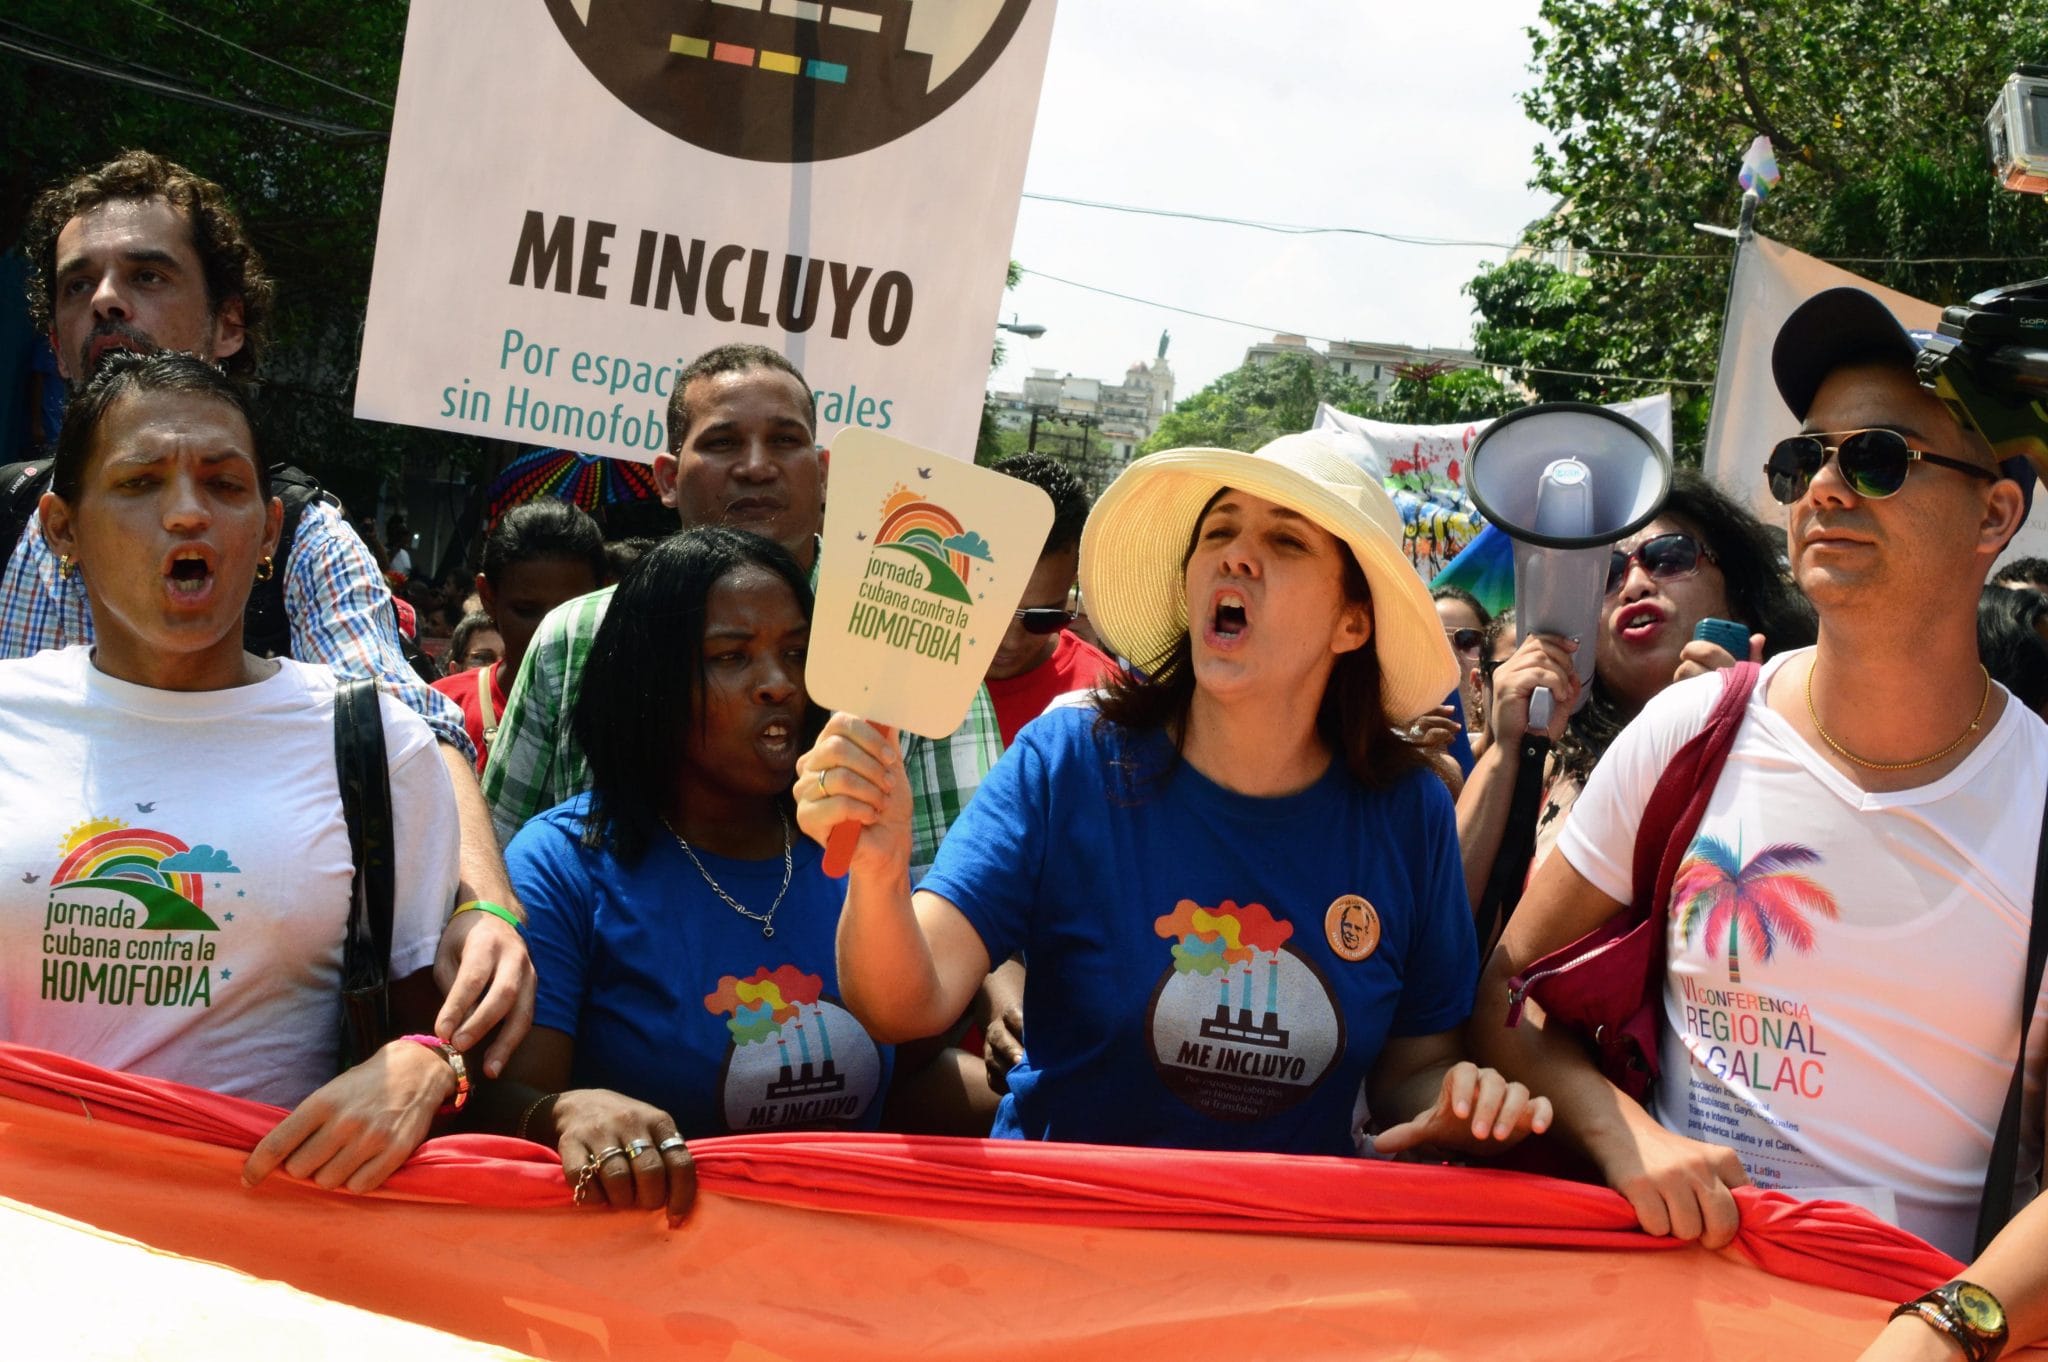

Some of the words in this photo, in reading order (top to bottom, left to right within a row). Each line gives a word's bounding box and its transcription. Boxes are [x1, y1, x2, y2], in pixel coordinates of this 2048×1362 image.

[508, 209, 617, 300] ME
[629, 228, 914, 347] INCLUYO
[499, 328, 561, 377] Por
[571, 351, 684, 398] espaci
[812, 384, 894, 430] rales
[440, 377, 491, 423] sin
[504, 385, 665, 451] Homofob
[864, 550, 924, 589] jornada
[858, 580, 910, 611] cubana
[910, 596, 955, 625] contra
[955, 605, 969, 629] la
[847, 601, 962, 666] HOMOFOBIA
[44, 892, 136, 931] jornada
[42, 927, 121, 959] cubana
[125, 932, 193, 962] contra
[197, 933, 216, 961] la
[41, 958, 212, 1008] HOMOFOBIA
[1681, 975, 1698, 1003] VI
[1698, 987, 1812, 1021] CONFERENCIA
[1686, 1004, 1826, 1056] REGIONAL
[1176, 1040, 1213, 1068] ME
[1215, 1047, 1306, 1081] INCLUYO
[745, 1104, 778, 1126] ME
[781, 1095, 859, 1122] INCLUYO
[1731, 1129, 1756, 1144] Latina
[1756, 1138, 1763, 1148] y
[1765, 1138, 1773, 1148] el
[1754, 1163, 1781, 1179] Latina
